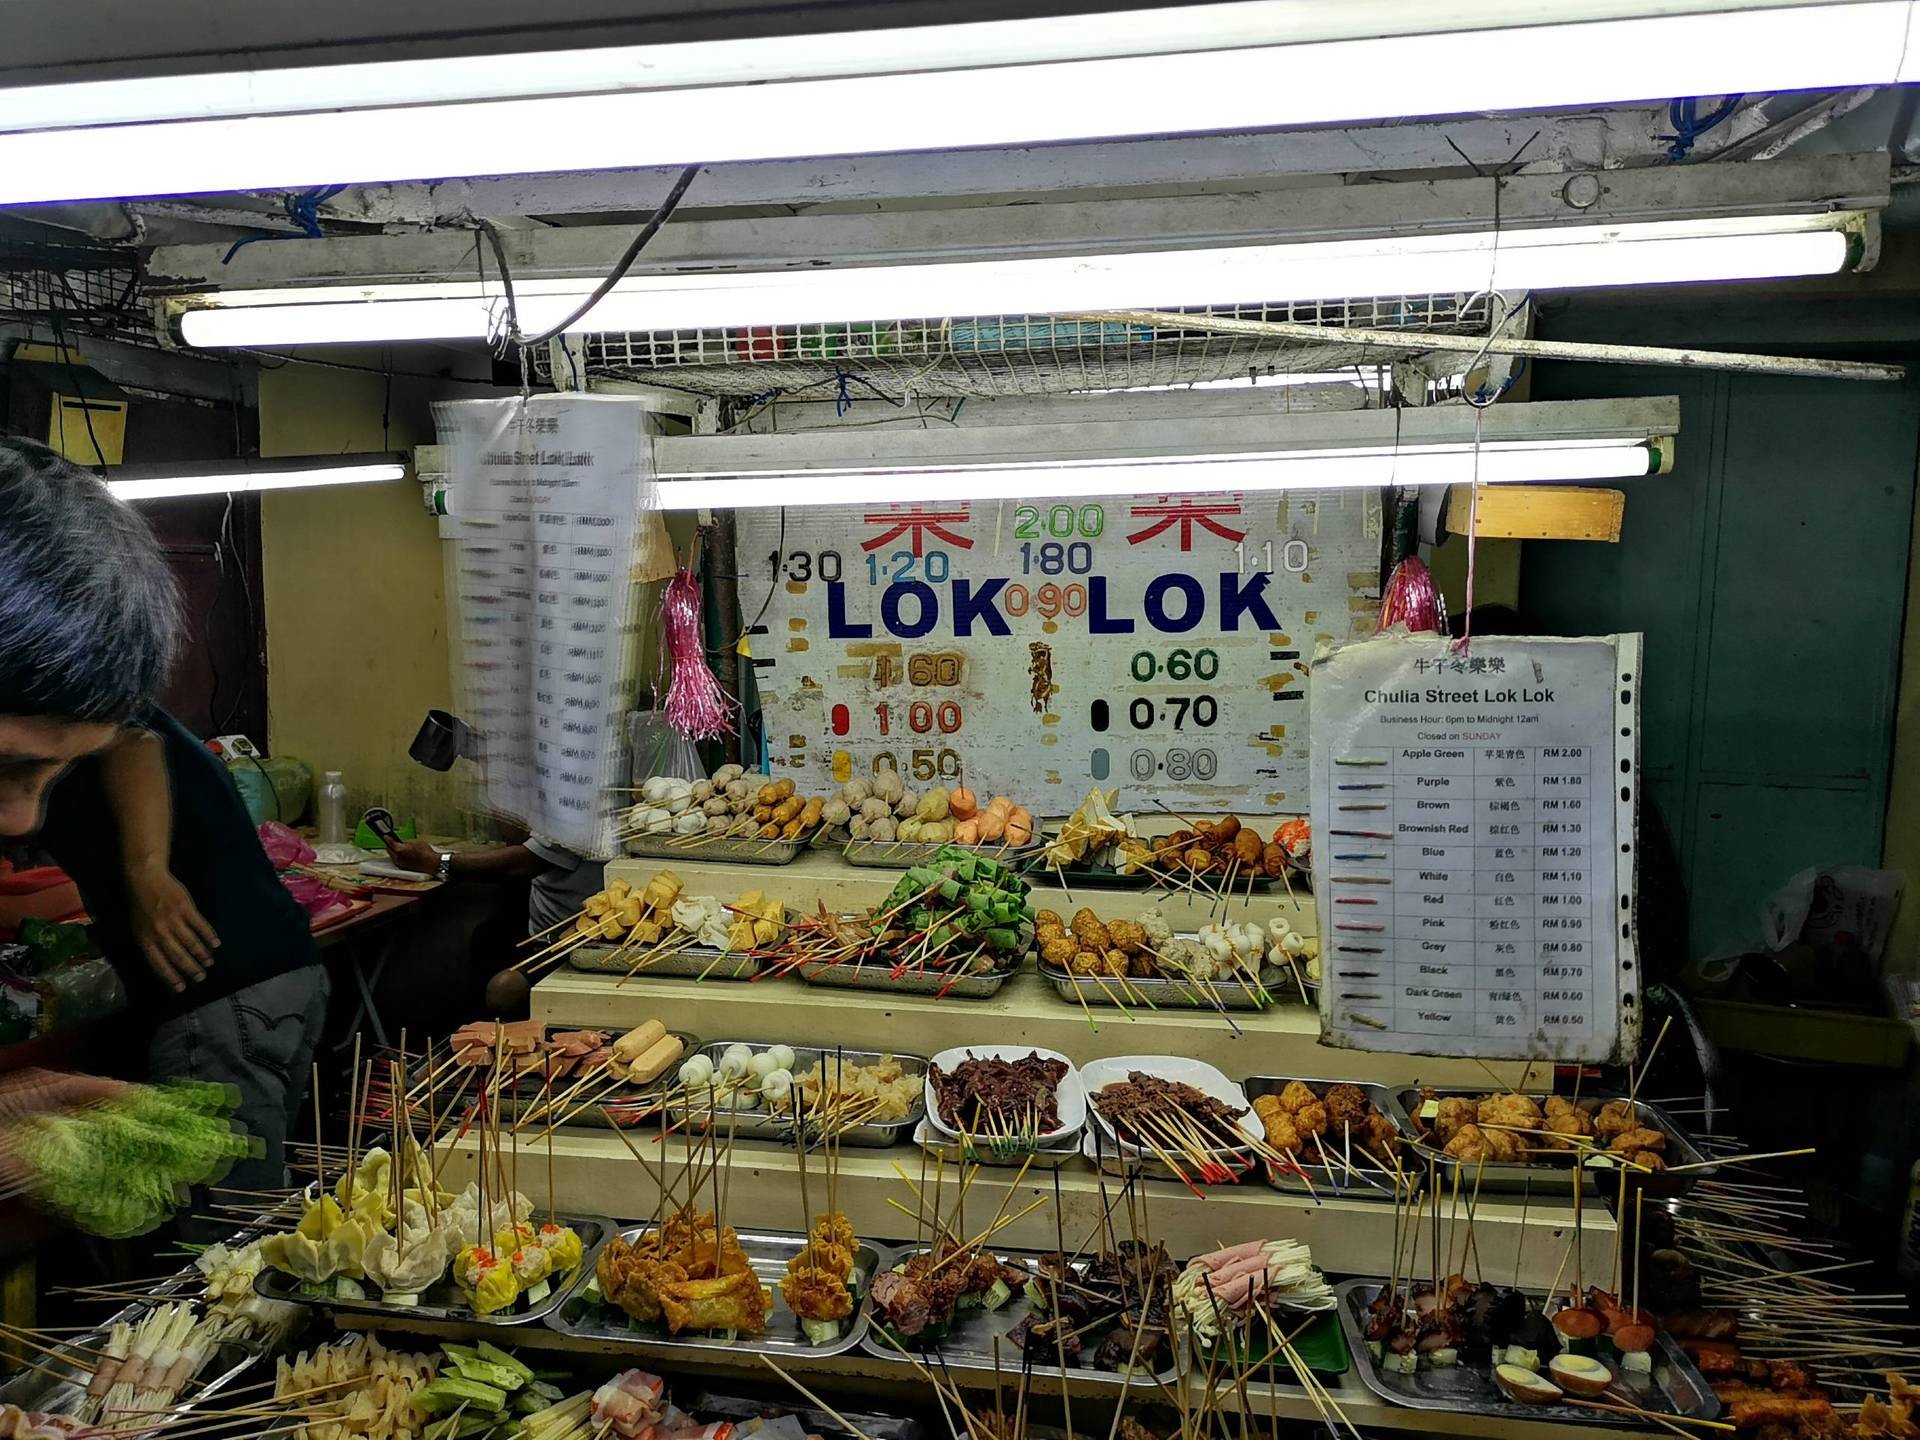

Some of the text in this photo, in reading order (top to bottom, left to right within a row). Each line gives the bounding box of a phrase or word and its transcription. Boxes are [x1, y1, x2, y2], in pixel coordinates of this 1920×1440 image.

[827, 571, 1283, 639] LOK LOK
[1364, 688, 1554, 704] Chulia Street Lok Lok
[1380, 715, 1418, 724] Business
[1466, 716, 1475, 724] to
[1477, 714, 1514, 725] Midnight
[1417, 731, 1502, 741] Closed on SUNDAY
[1402, 749, 1464, 760] Apple Green
[1543, 749, 1582, 758] RM 2.00
[1417, 777, 1450, 787] Purple
[1543, 777, 1582, 785] RM 1.80
[1417, 800, 1450, 809] Brown
[1543, 800, 1581, 809] RM 1.60
[1399, 824, 1469, 833] Brownish Red
[1543, 824, 1581, 833] RM 1.30
[1422, 847, 1445, 856] Blue
[1543, 847, 1581, 856] RM 1.20
[1419, 872, 1448, 881] White
[1543, 872, 1582, 881] RM 1.10
[1424, 895, 1444, 904] Red
[1542, 896, 1582, 905] RM 1.00
[1422, 918, 1445, 927] Pink
[1542, 919, 1558, 928] RM
[1542, 943, 1558, 952] RM
[1419, 965, 1448, 975] Black
[1543, 968, 1559, 977] RM
[1406, 988, 1462, 999] Dark Green
[1543, 992, 1559, 1001] RM
[1418, 1012, 1451, 1021] Yellow
[1544, 1015, 1560, 1024] RM
